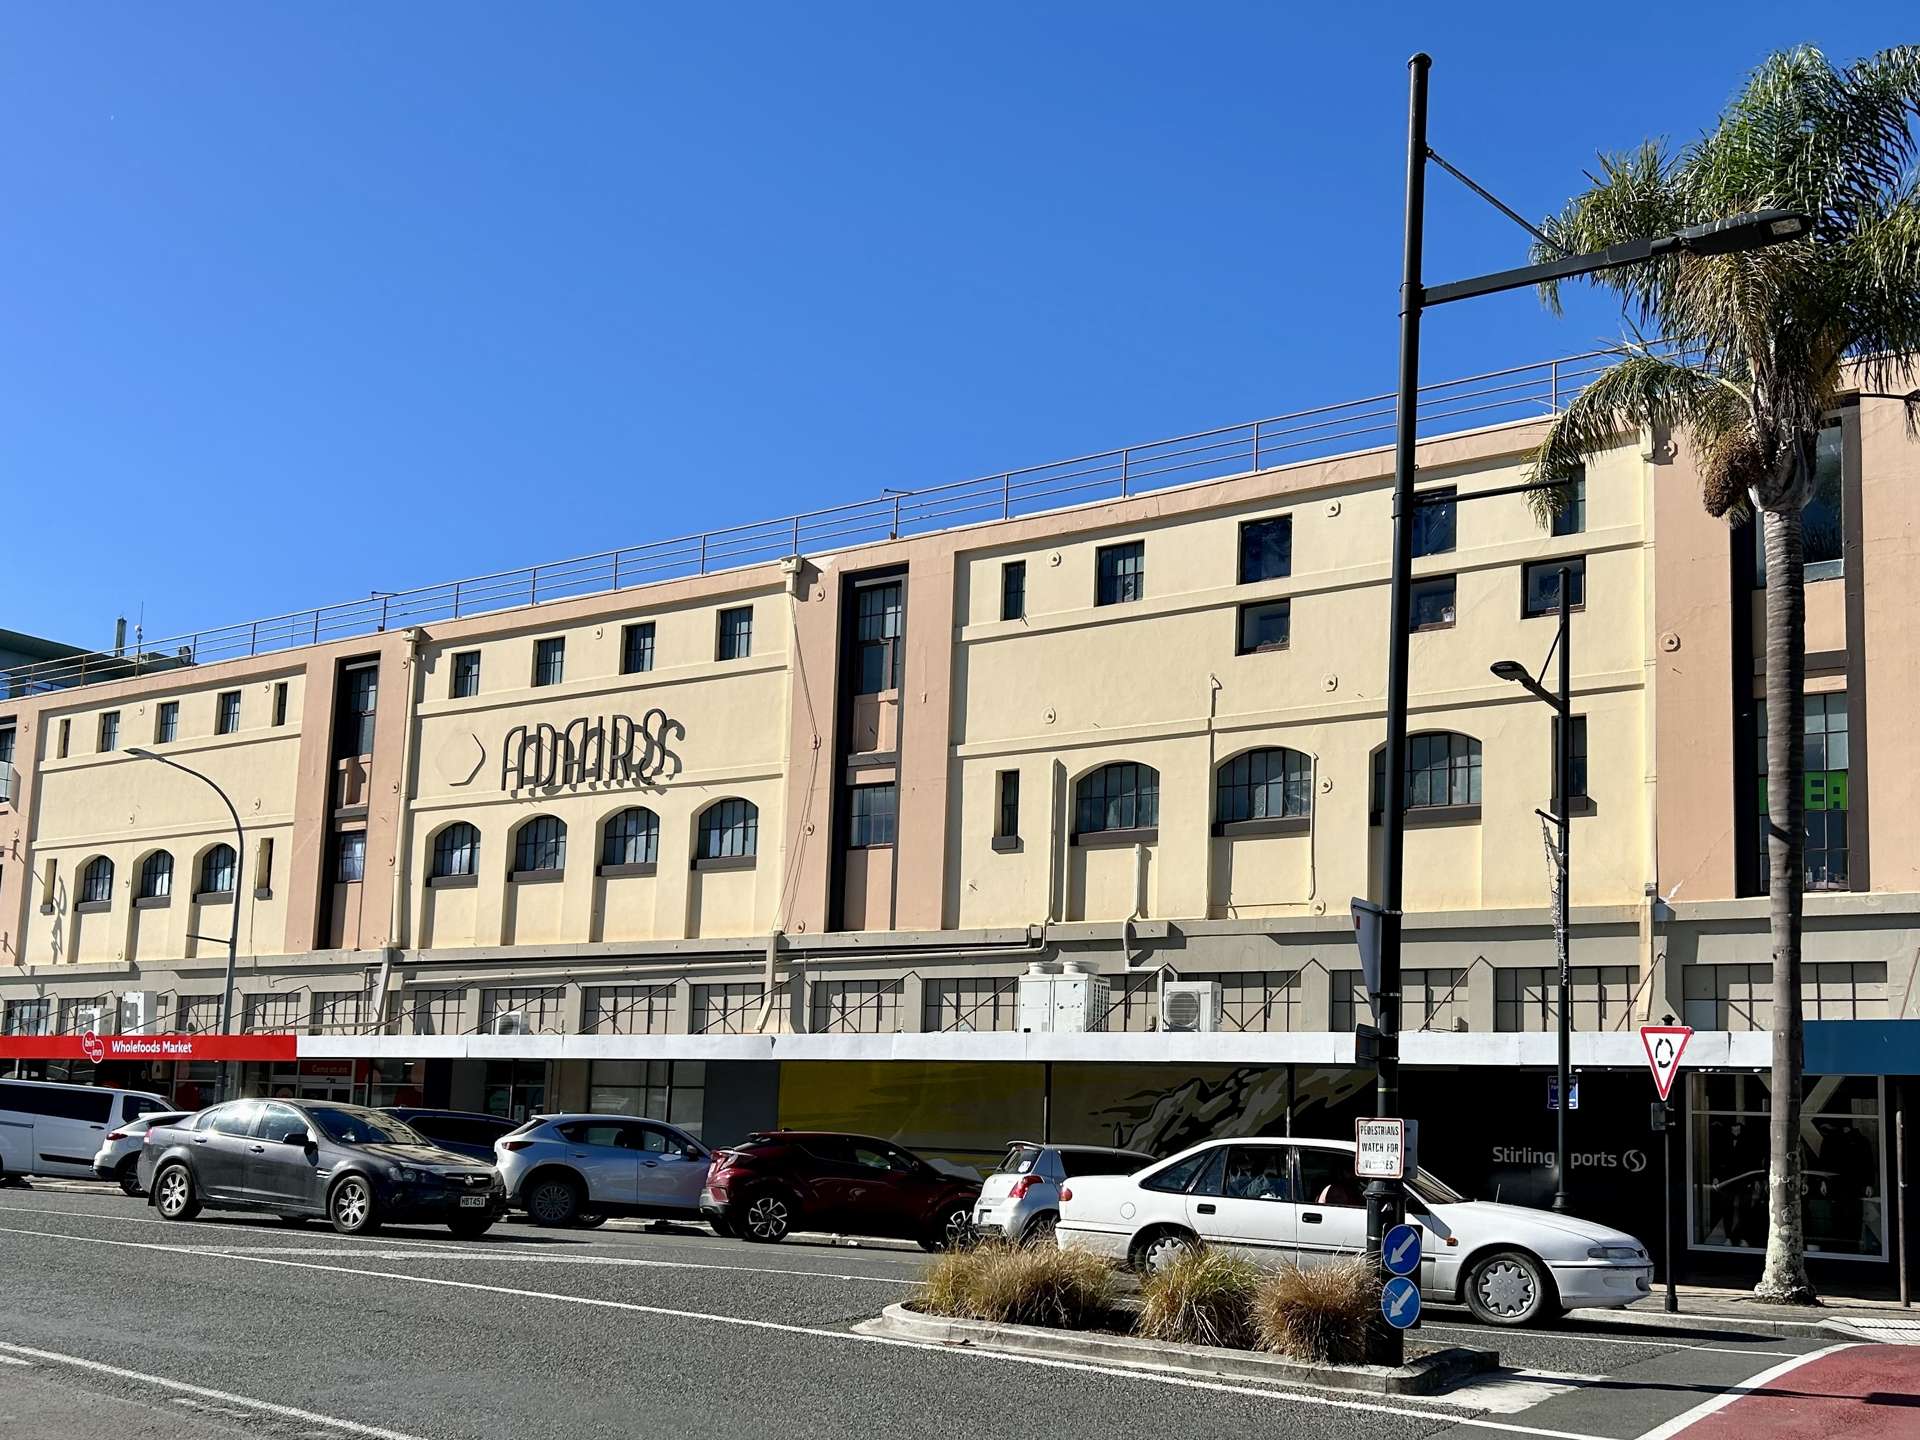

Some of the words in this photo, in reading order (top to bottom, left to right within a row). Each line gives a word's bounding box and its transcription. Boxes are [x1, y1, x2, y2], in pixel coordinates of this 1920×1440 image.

[500, 708, 667, 790] ADAIRS
[84, 1037, 95, 1047] bin
[111, 1040, 161, 1053] Wholefoods
[162, 1040, 193, 1054] Market
[92, 1048, 102, 1056] inn
[1360, 1125, 1399, 1136] PEDESTRIANS
[1361, 1142, 1384, 1152] WATCH
[1386, 1143, 1399, 1153] FOR
[1492, 1146, 1555, 1168] Stirling
[1571, 1151, 1617, 1169] ports
